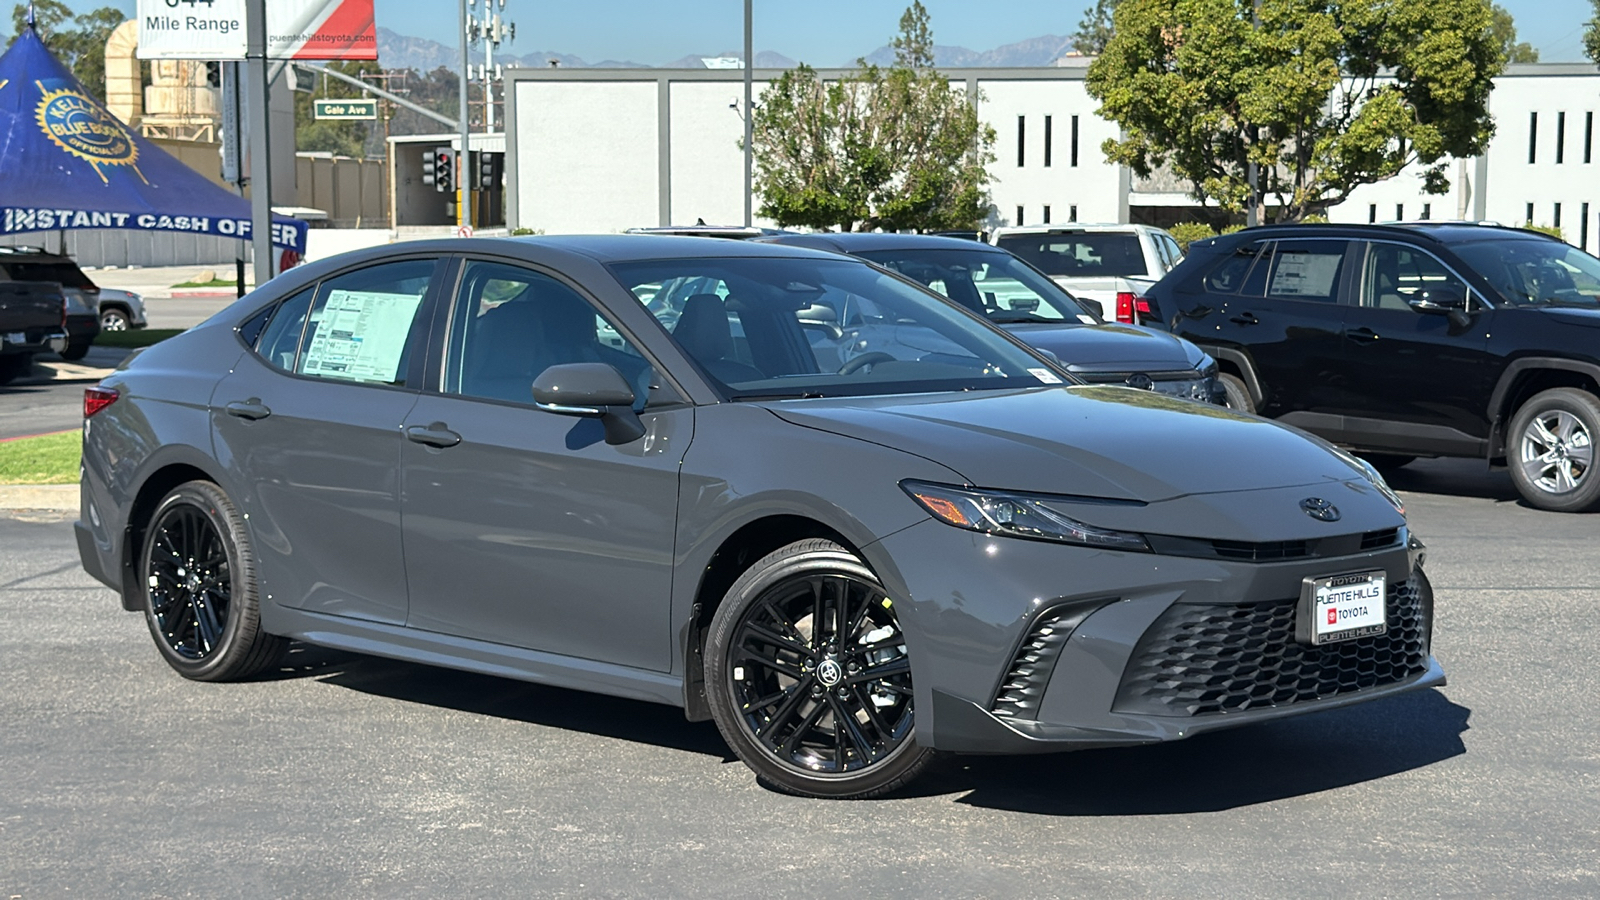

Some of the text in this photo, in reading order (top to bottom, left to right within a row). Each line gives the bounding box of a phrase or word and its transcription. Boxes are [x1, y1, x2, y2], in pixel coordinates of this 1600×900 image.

[146, 16, 240, 34] Mile Range
[269, 33, 375, 44] puentehillstoyota.com
[324, 104, 367, 115] Gale Ave
[50, 121, 91, 136] BLUE
[4, 208, 298, 247] INSTANT CASH OFER
[1332, 574, 1369, 586] TOYOTA
[1316, 587, 1379, 606] PUENTE HILLS
[1338, 606, 1368, 619] TOYOTA
[1320, 626, 1383, 642] PUENTE HILLS
